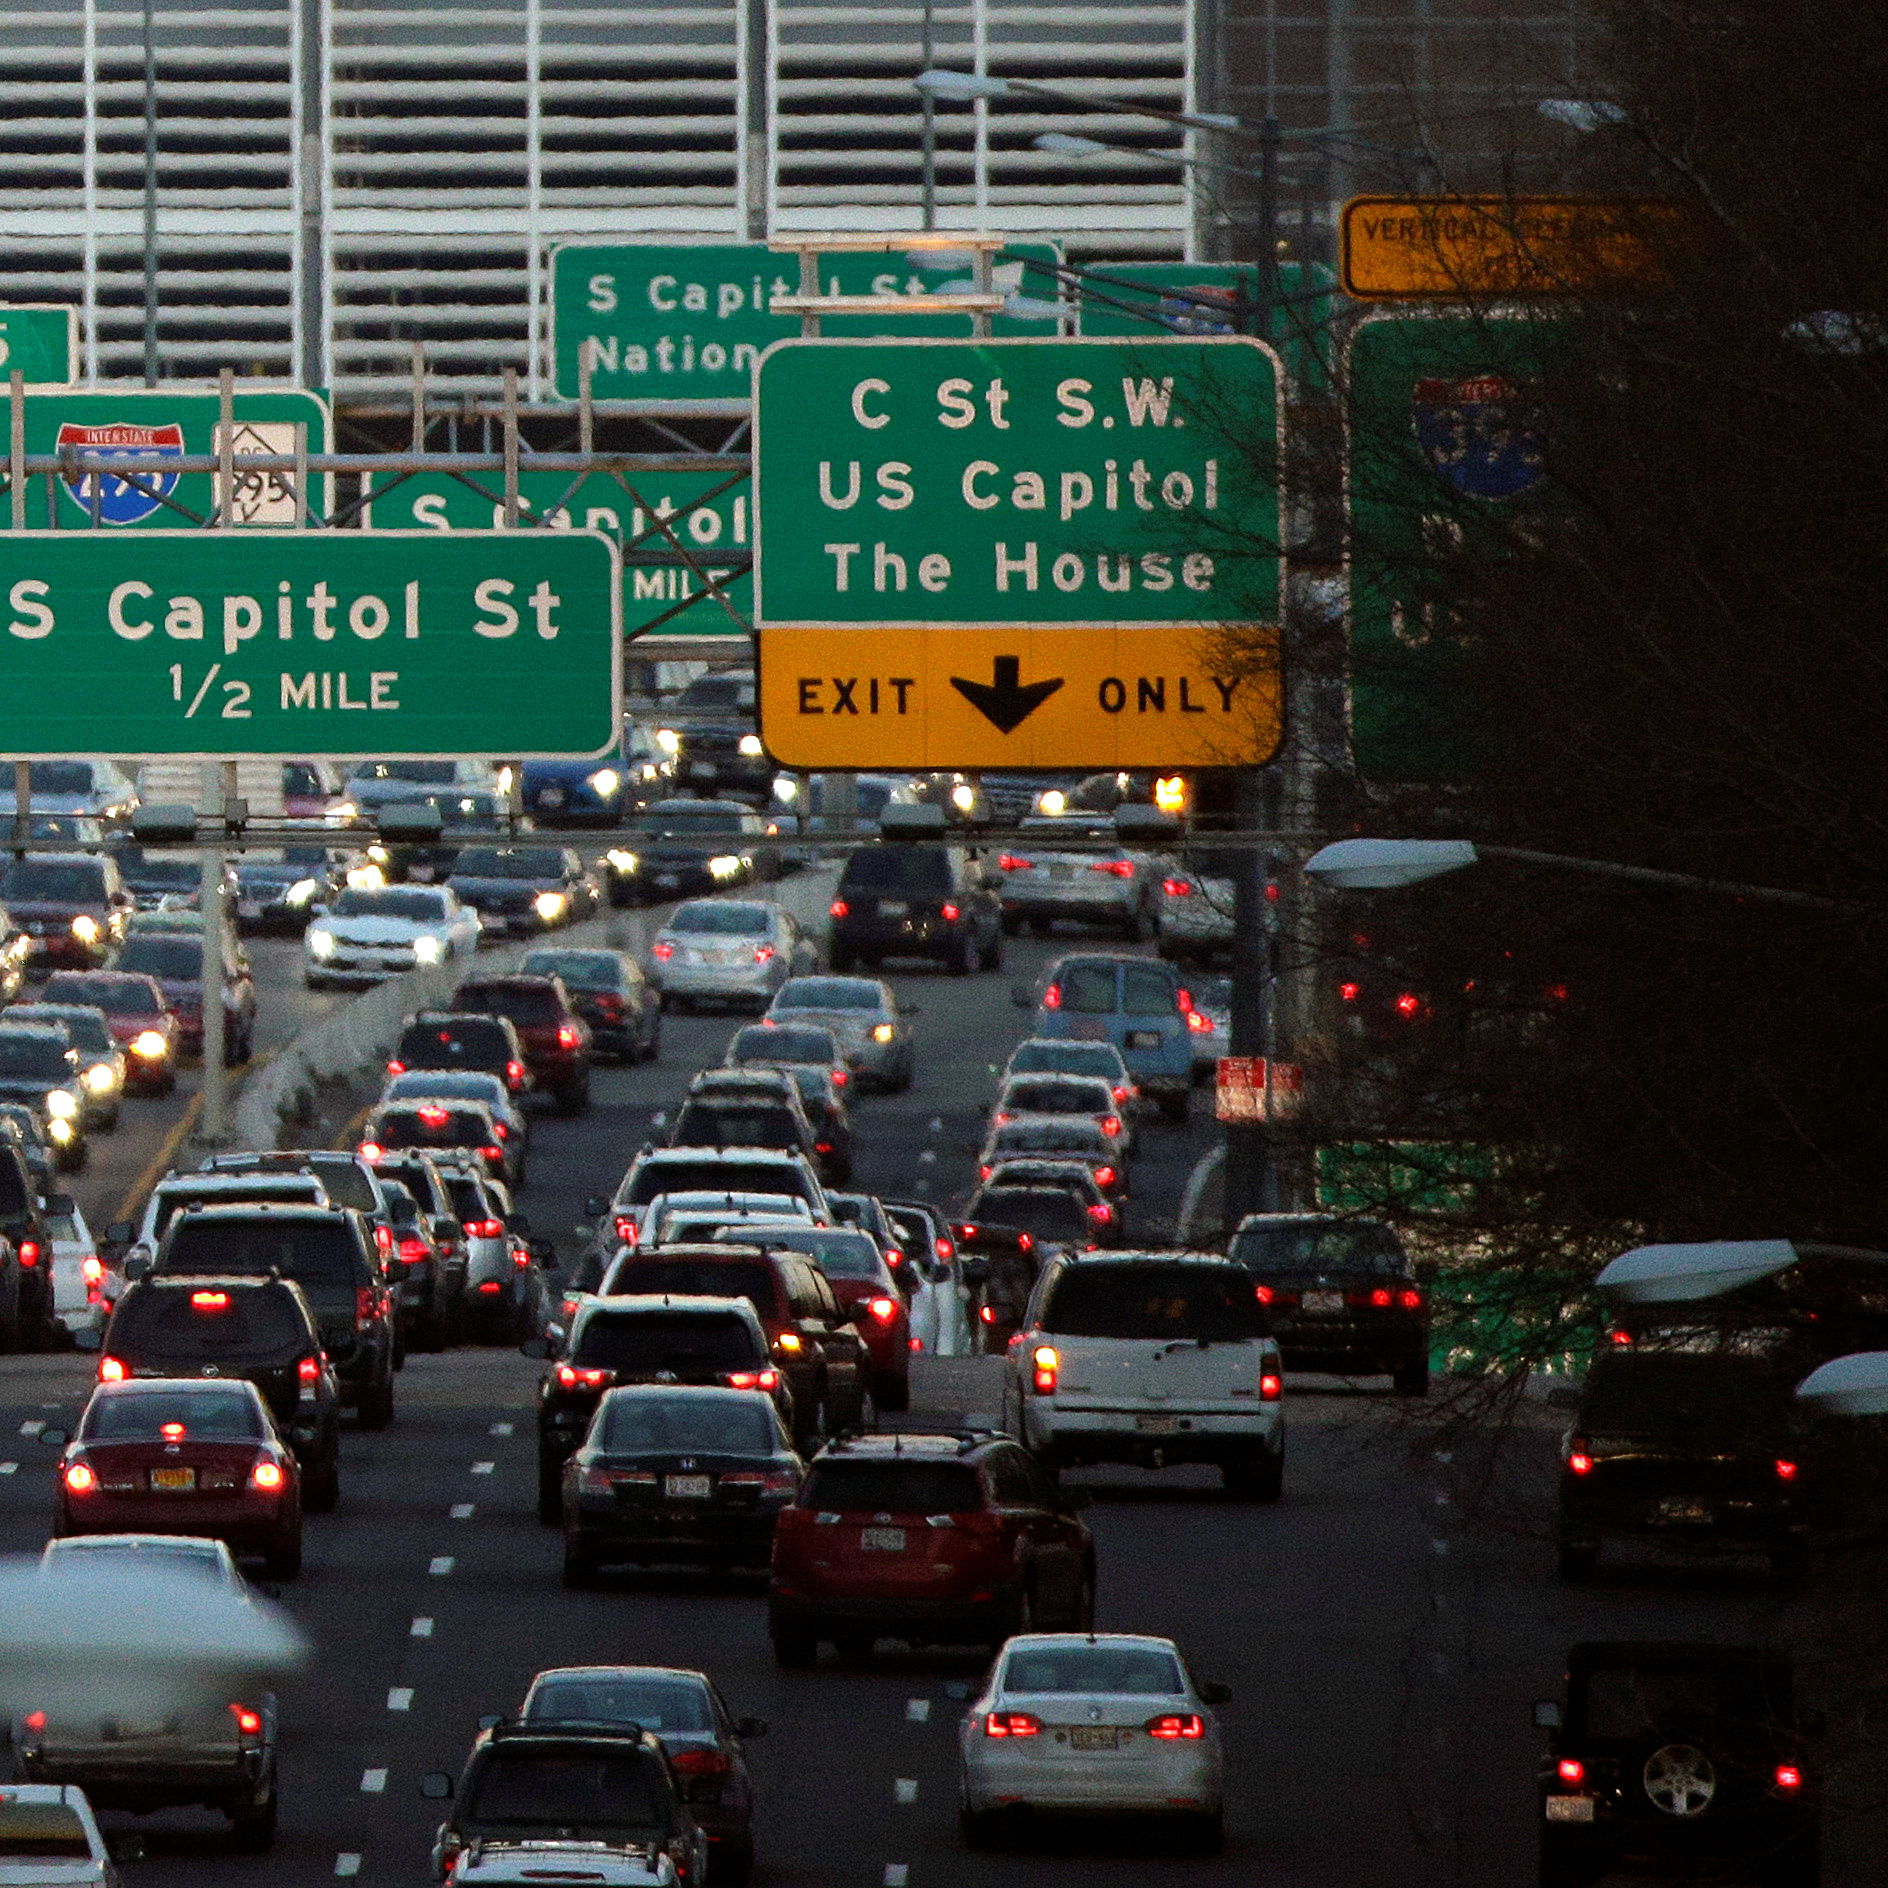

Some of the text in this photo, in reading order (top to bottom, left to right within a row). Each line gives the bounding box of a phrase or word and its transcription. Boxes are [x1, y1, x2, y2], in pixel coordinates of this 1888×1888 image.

[588, 275, 618, 312] S
[852, 377, 1185, 429] C St S.W.
[819, 459, 1220, 520] US Capitol
[825, 542, 1217, 593] The House
[9, 579, 561, 653] S Capitol St
[170, 664, 400, 718] 1/2 MILE
[799, 678, 1243, 713] EXIT ONLY
